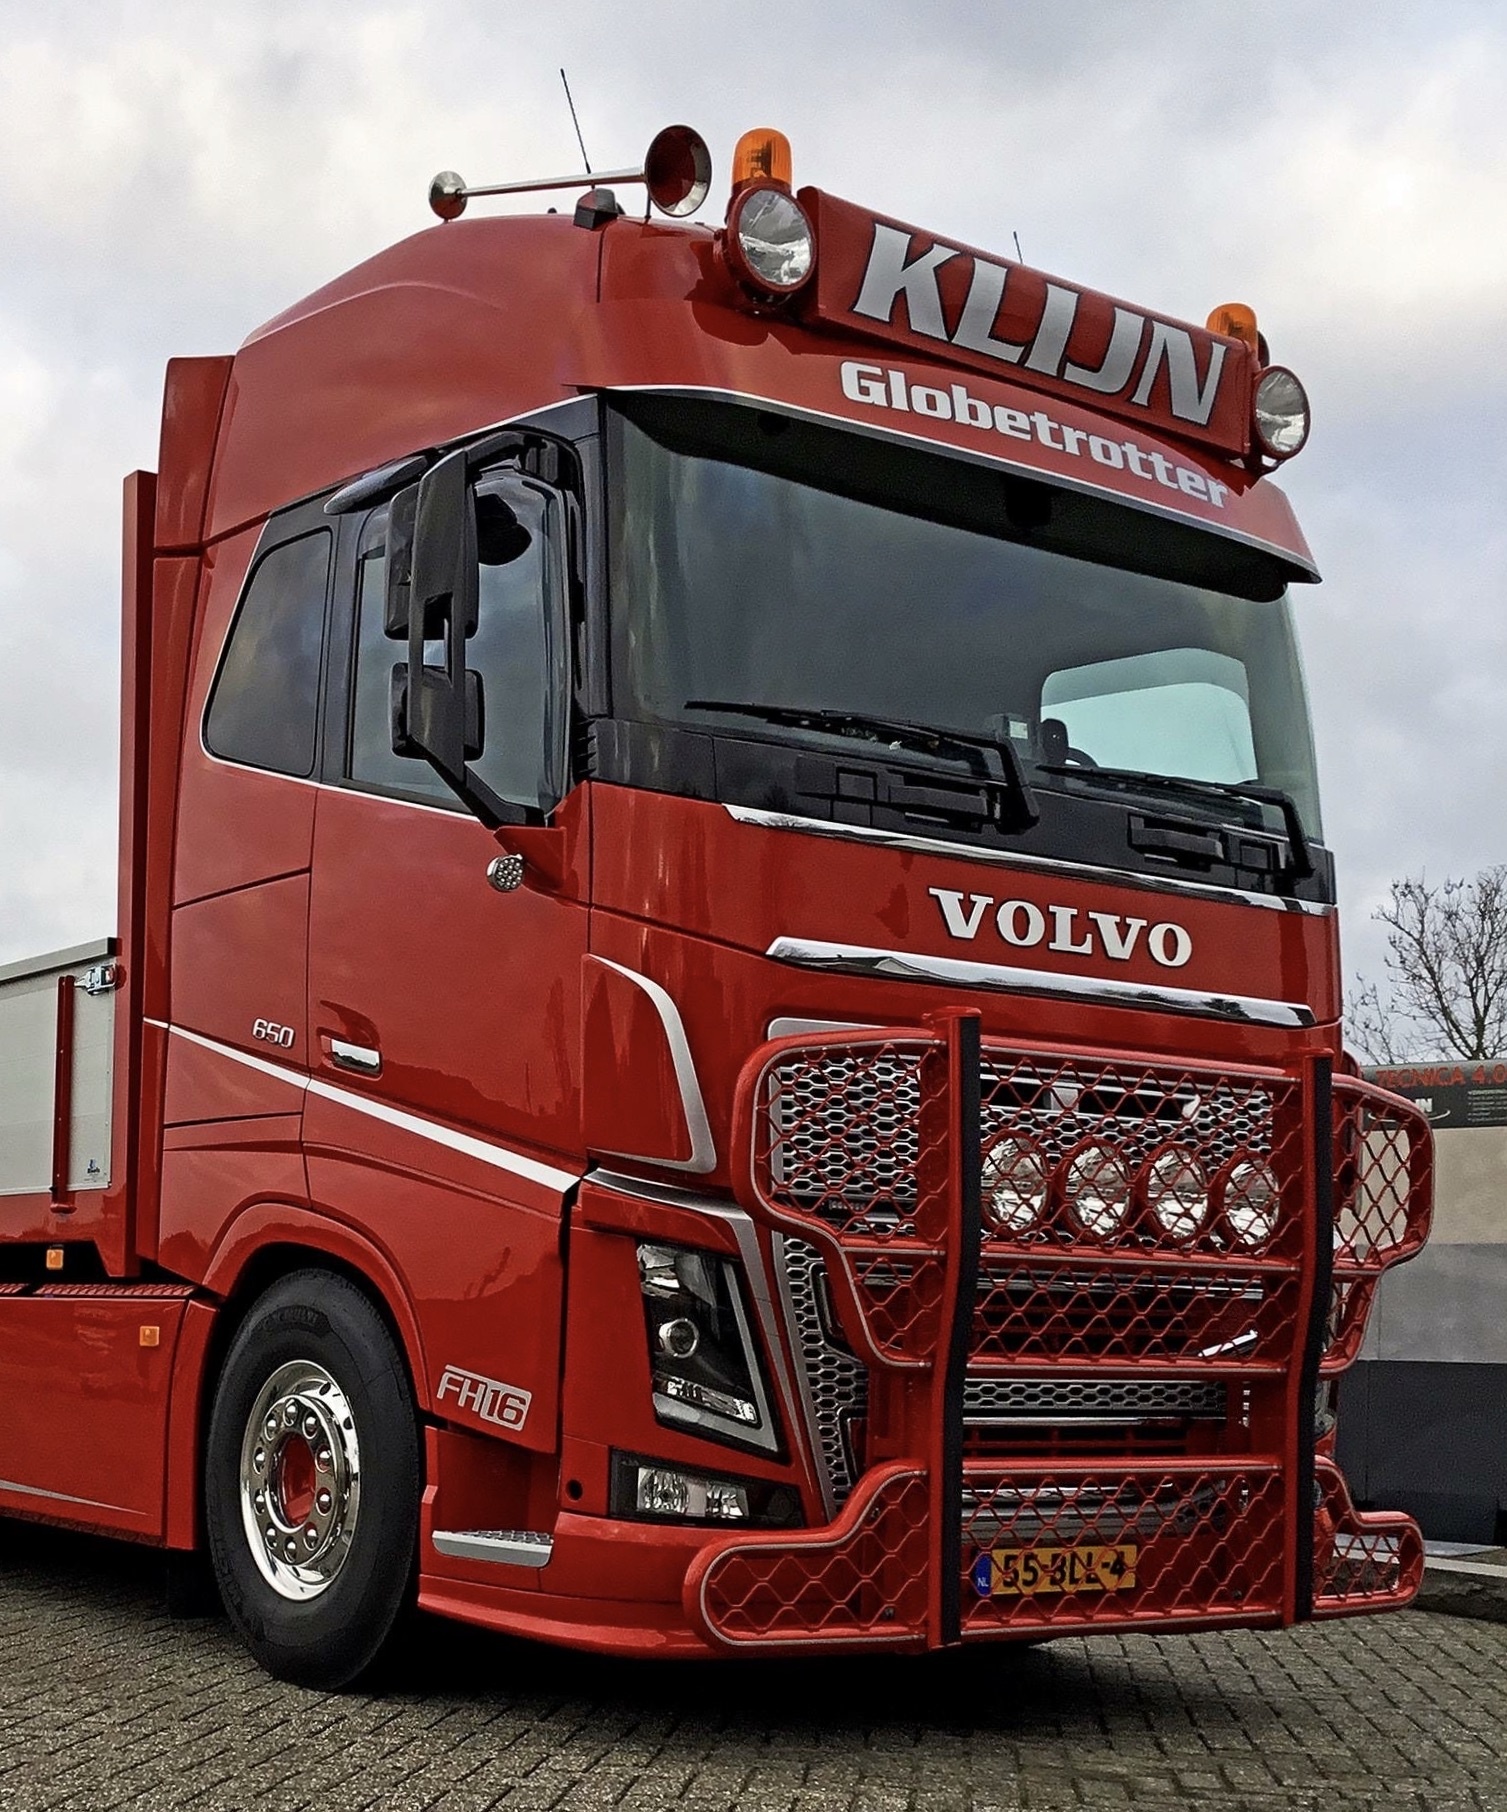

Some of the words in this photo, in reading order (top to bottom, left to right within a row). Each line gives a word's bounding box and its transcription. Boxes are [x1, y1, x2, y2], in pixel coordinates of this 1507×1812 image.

[852, 222, 1229, 427] KLIJN
[840, 361, 1229, 508] Globetrotter
[928, 887, 1193, 967] VOLVO
[252, 1018, 295, 1048] 650
[437, 1366, 531, 1430] FH16
[977, 1576, 989, 1587] NL
